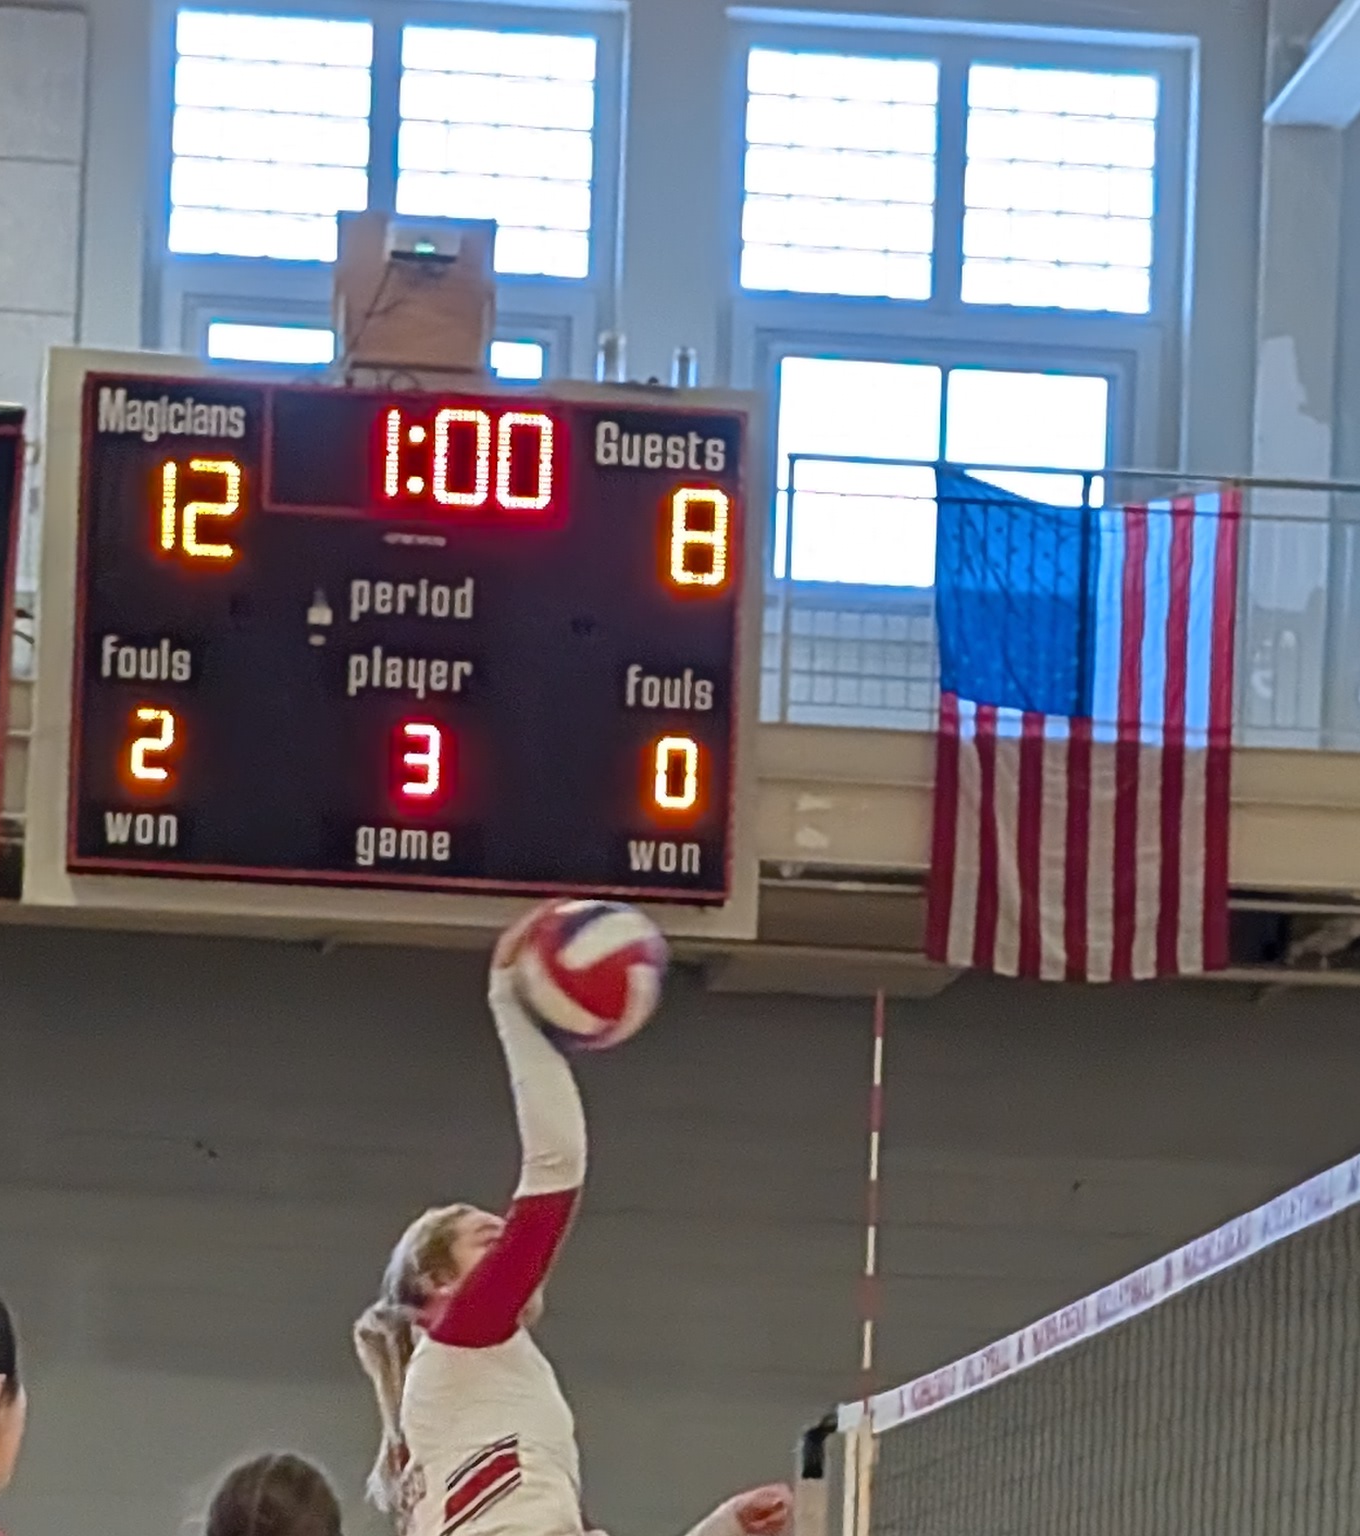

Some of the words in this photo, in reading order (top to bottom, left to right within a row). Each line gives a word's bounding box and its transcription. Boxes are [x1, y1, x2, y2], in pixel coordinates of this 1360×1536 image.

[97, 387, 246, 442] Magicians
[385, 408, 554, 510] 1:00
[595, 421, 726, 472] Guests
[161, 459, 241, 558] 12
[670, 487, 729, 586] 8
[349, 578, 474, 622] period
[101, 634, 192, 682] fouls
[347, 646, 473, 699] player
[625, 664, 715, 710] fouls
[131, 708, 175, 780] 2
[402, 723, 441, 795] 3
[654, 735, 699, 810] 0
[104, 811, 179, 847] won
[356, 826, 451, 866] game
[627, 840, 701, 874] won
